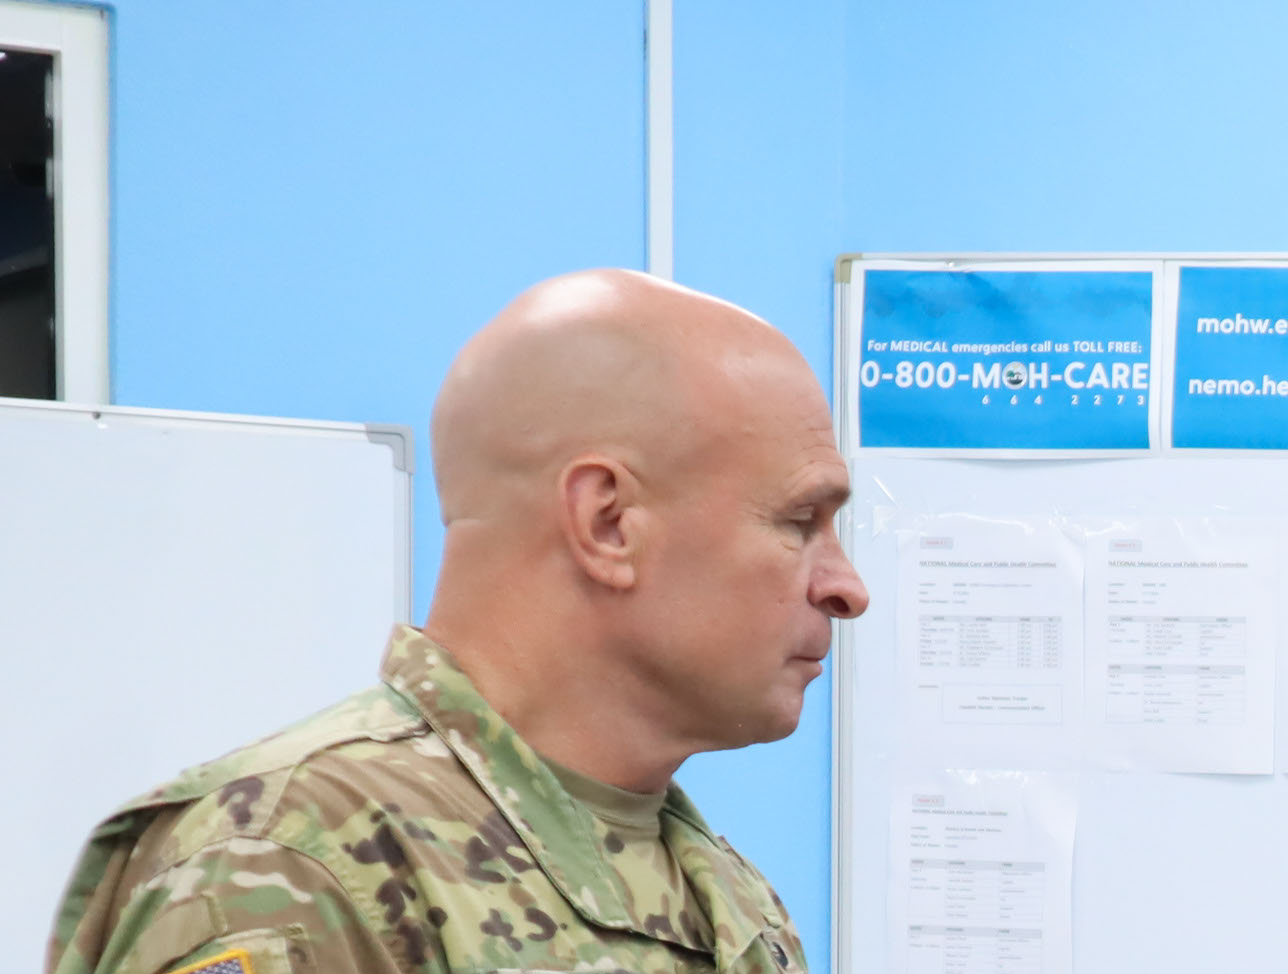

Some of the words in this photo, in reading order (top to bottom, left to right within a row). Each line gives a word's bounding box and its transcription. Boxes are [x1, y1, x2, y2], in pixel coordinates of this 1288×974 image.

[867, 340, 888, 353] For
[890, 340, 949, 353] MEDICAL
[951, 341, 1028, 356] emergencies
[1030, 341, 1052, 353] call
[1054, 343, 1069, 353] us
[1073, 341, 1104, 353] TOLL
[1107, 341, 1143, 353] FREE:
